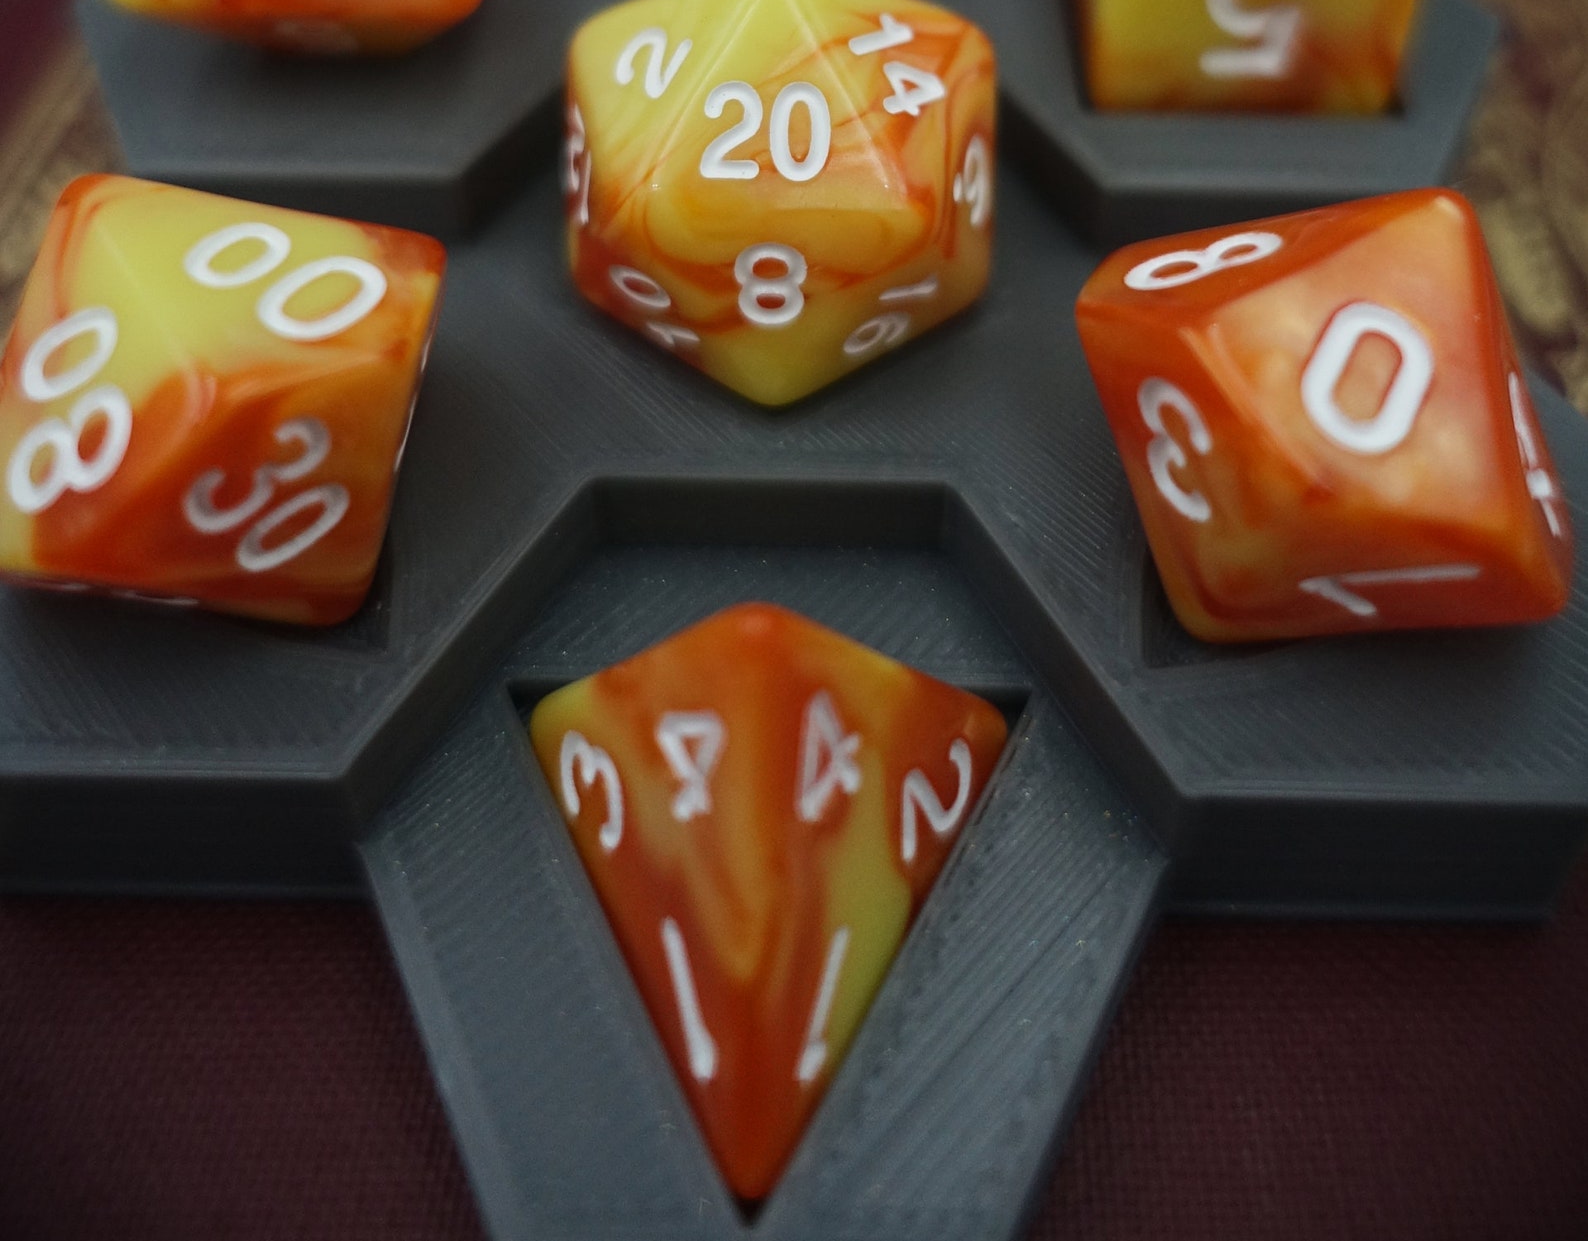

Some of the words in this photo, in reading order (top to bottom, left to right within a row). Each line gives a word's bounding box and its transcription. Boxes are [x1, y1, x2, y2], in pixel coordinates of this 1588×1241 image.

[615, 27, 692, 99] 2
[848, 14, 946, 116] 14
[699, 81, 832, 182] 20
[183, 222, 388, 341] 00
[734, 242, 807, 326] 8
[1124, 232, 1283, 291] 8
[7, 305, 132, 514] 80
[1300, 301, 1434, 455] 0
[183, 416, 350, 573] 30
[1137, 377, 1212, 523] 3
[1299, 564, 1481, 617] 1
[560, 730, 623, 852] 3
[655, 710, 725, 822] 4
[796, 689, 861, 822] 4
[902, 738, 972, 863] 2
[661, 917, 718, 1080] 1
[795, 926, 849, 1080] 1
